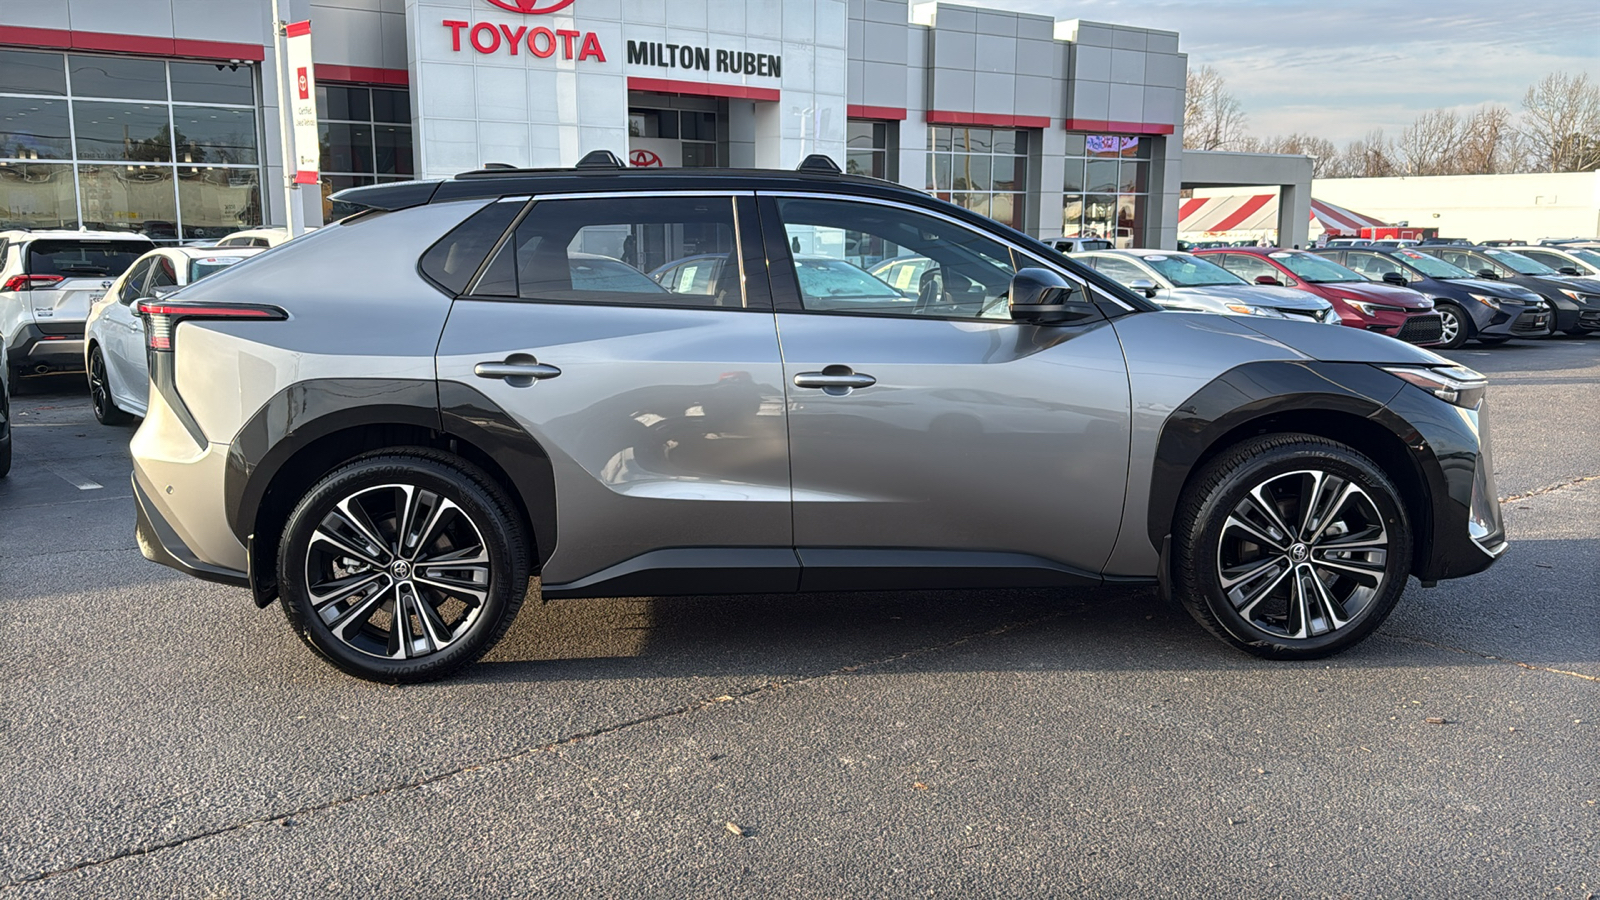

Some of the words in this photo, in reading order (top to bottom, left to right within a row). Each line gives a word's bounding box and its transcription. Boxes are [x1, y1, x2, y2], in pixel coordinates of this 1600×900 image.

[443, 20, 607, 63] TOYOTA
[627, 40, 710, 71] MILTON
[716, 49, 782, 78] RUBEN
